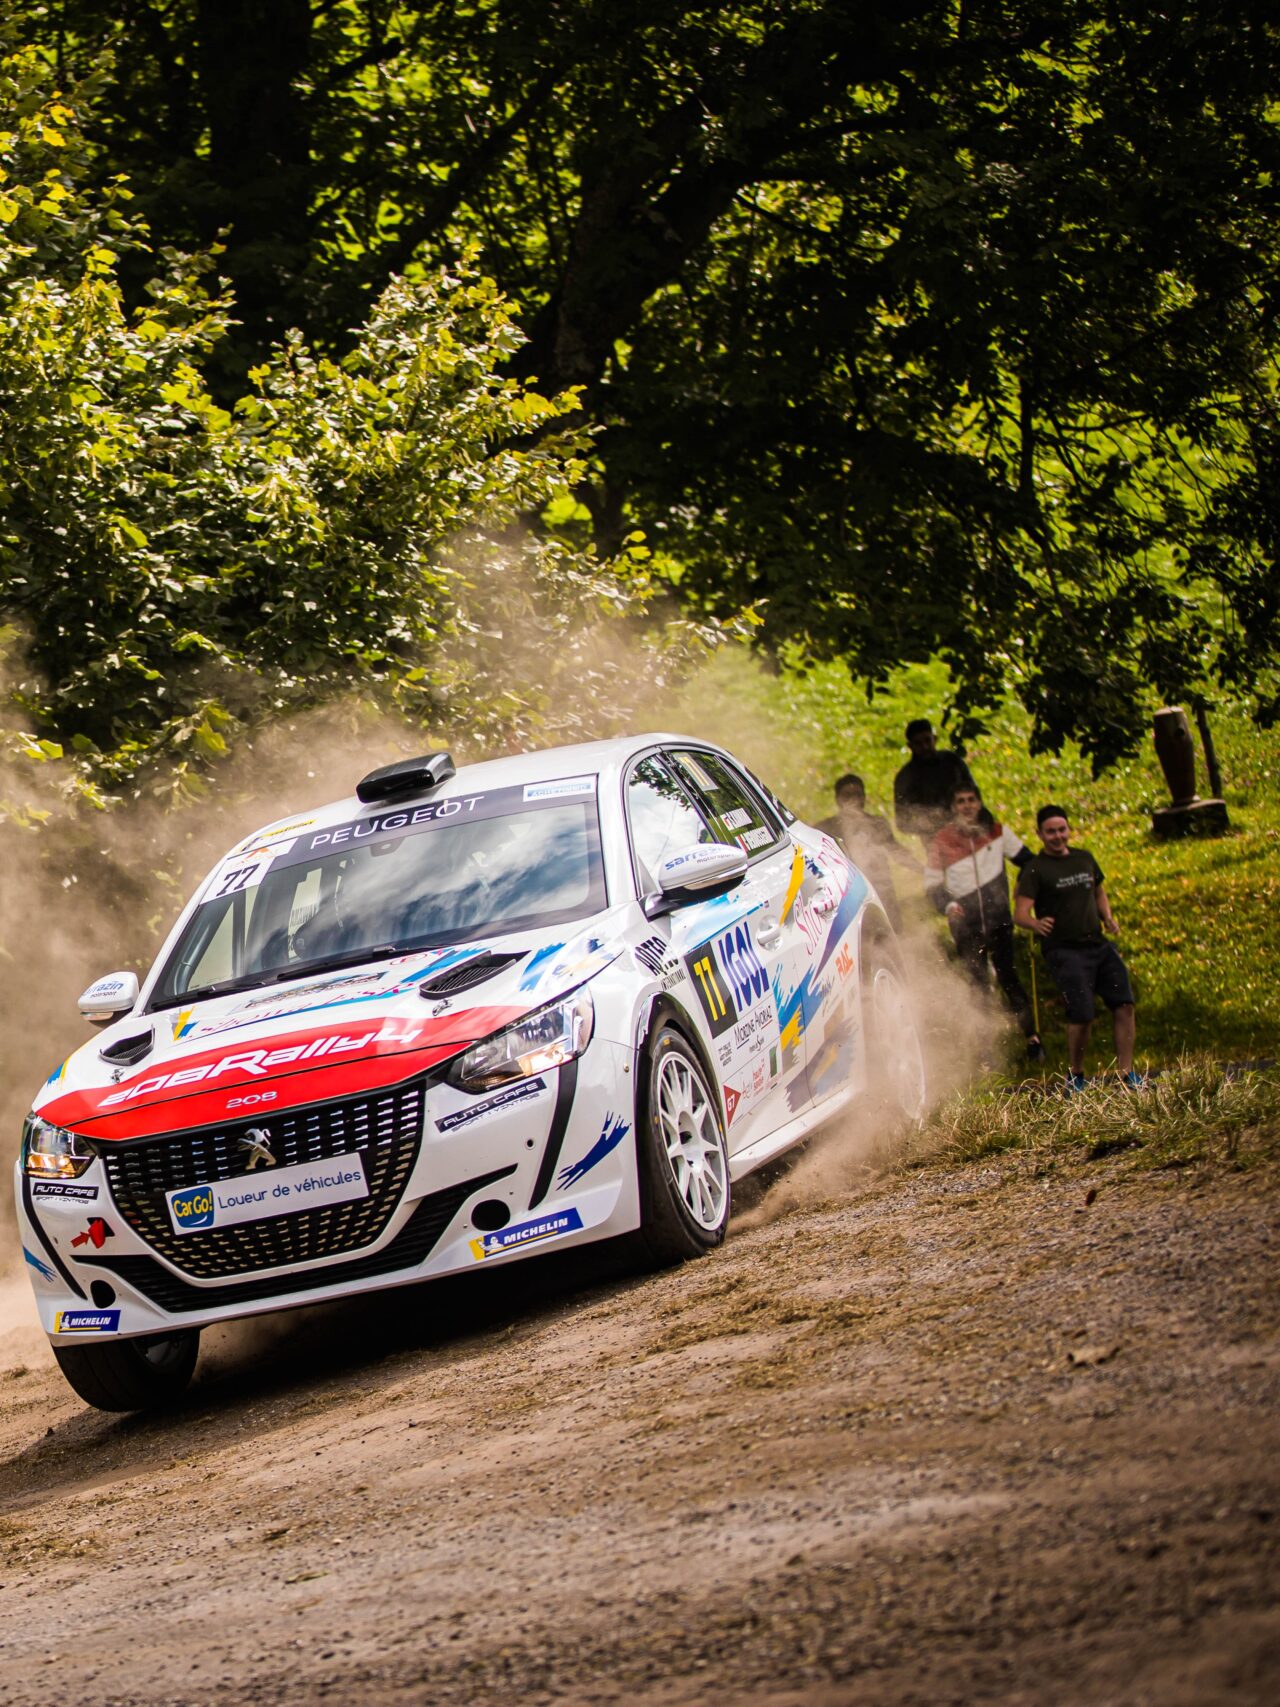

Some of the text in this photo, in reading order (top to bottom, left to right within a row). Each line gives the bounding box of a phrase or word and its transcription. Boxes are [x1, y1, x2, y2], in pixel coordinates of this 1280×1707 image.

[310, 796, 484, 849] PEUGEOT
[216, 863, 260, 897] 77
[718, 921, 770, 1012] IGOL
[226, 1091, 277, 1109] 208
[443, 1082, 539, 1127] AUTO CAFE
[36, 1185, 63, 1194] AUTO
[218, 1170, 362, 1209] Loueur de véhicules
[504, 1217, 568, 1244] MICHELIN
[70, 1316, 111, 1326] MICHELIN
